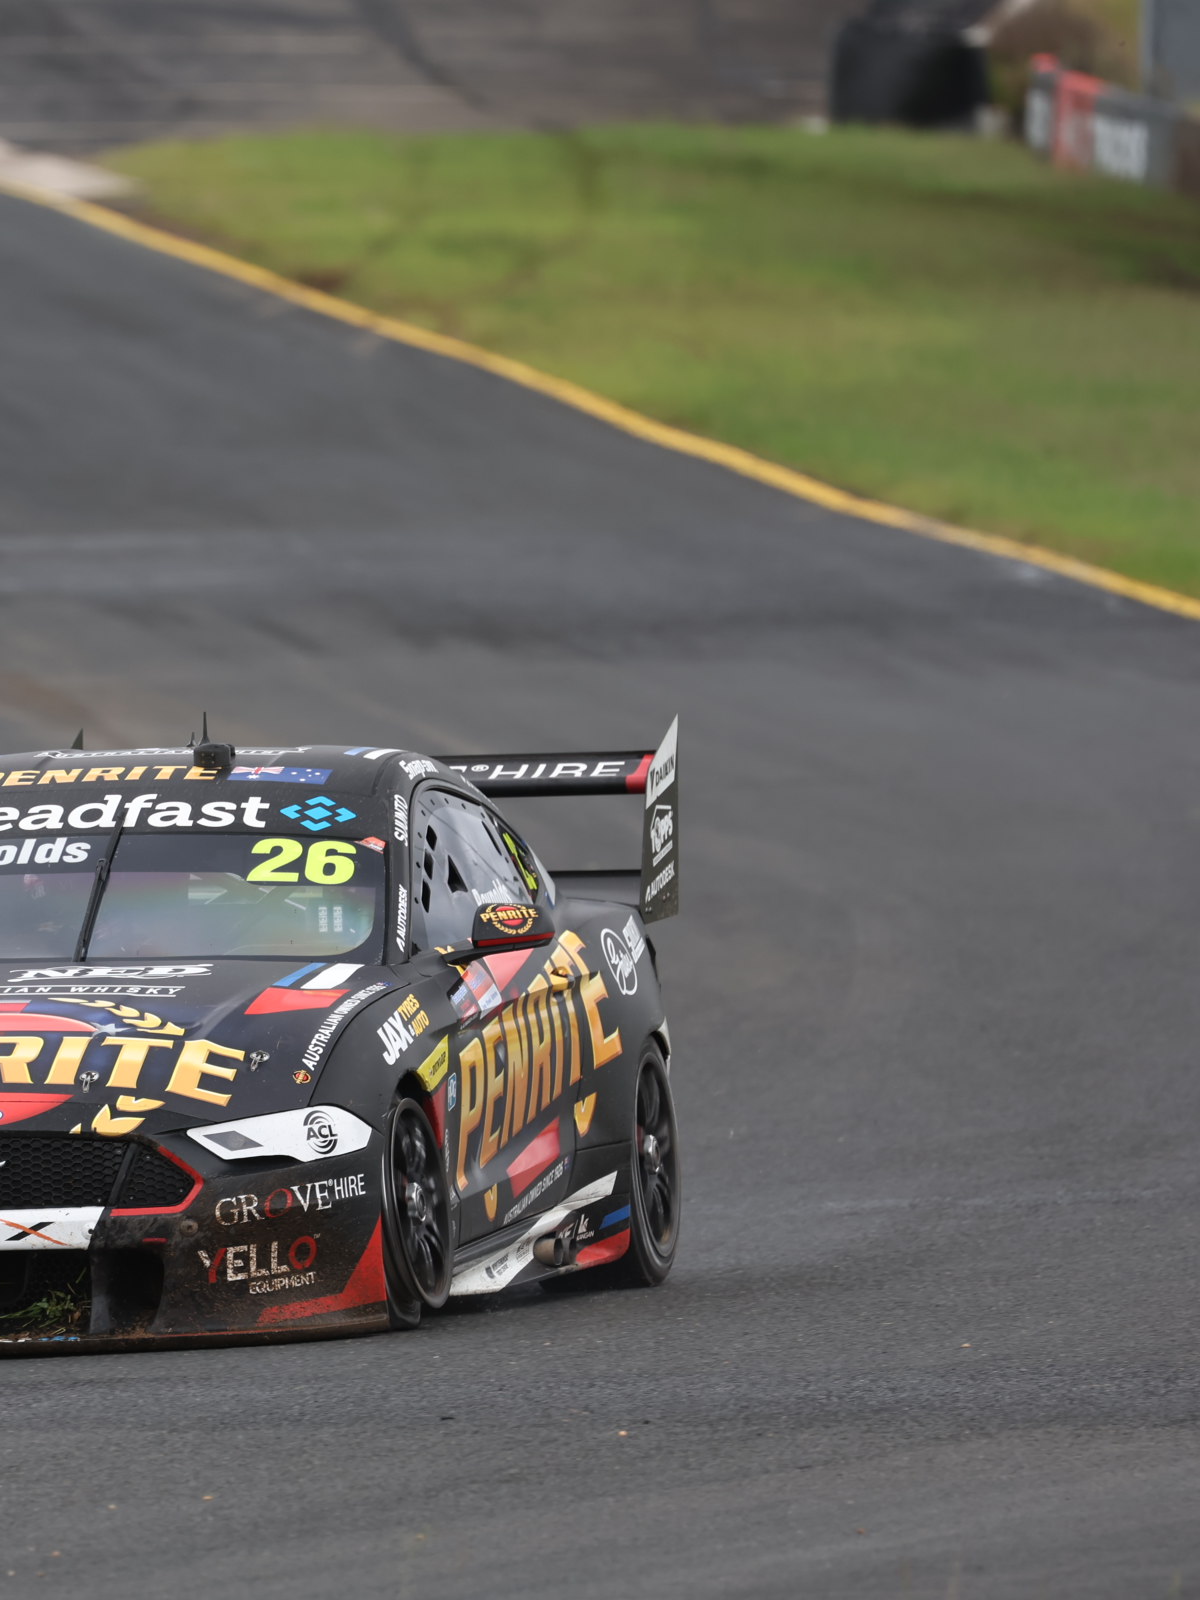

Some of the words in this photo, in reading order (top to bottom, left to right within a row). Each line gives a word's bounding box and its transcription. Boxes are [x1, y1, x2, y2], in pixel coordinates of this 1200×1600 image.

[655, 755, 675, 782] DAIKIN
[246, 838, 357, 885] 26
[396, 884, 408, 940] AUTODESK
[480, 908, 539, 922] PENRITE
[70, 986, 182, 996] WHISKY
[397, 994, 420, 1021] TYRES
[412, 1010, 430, 1037] AUTO
[302, 1013, 345, 1071] AUSTRALIAN
[377, 1010, 414, 1065] JAX
[457, 930, 623, 1191] PENRITE
[306, 1124, 338, 1141] ACL
[334, 1173, 367, 1200] HIRE
[198, 1236, 317, 1284] YELLO
[249, 1271, 317, 1294] EQUIPMENT
